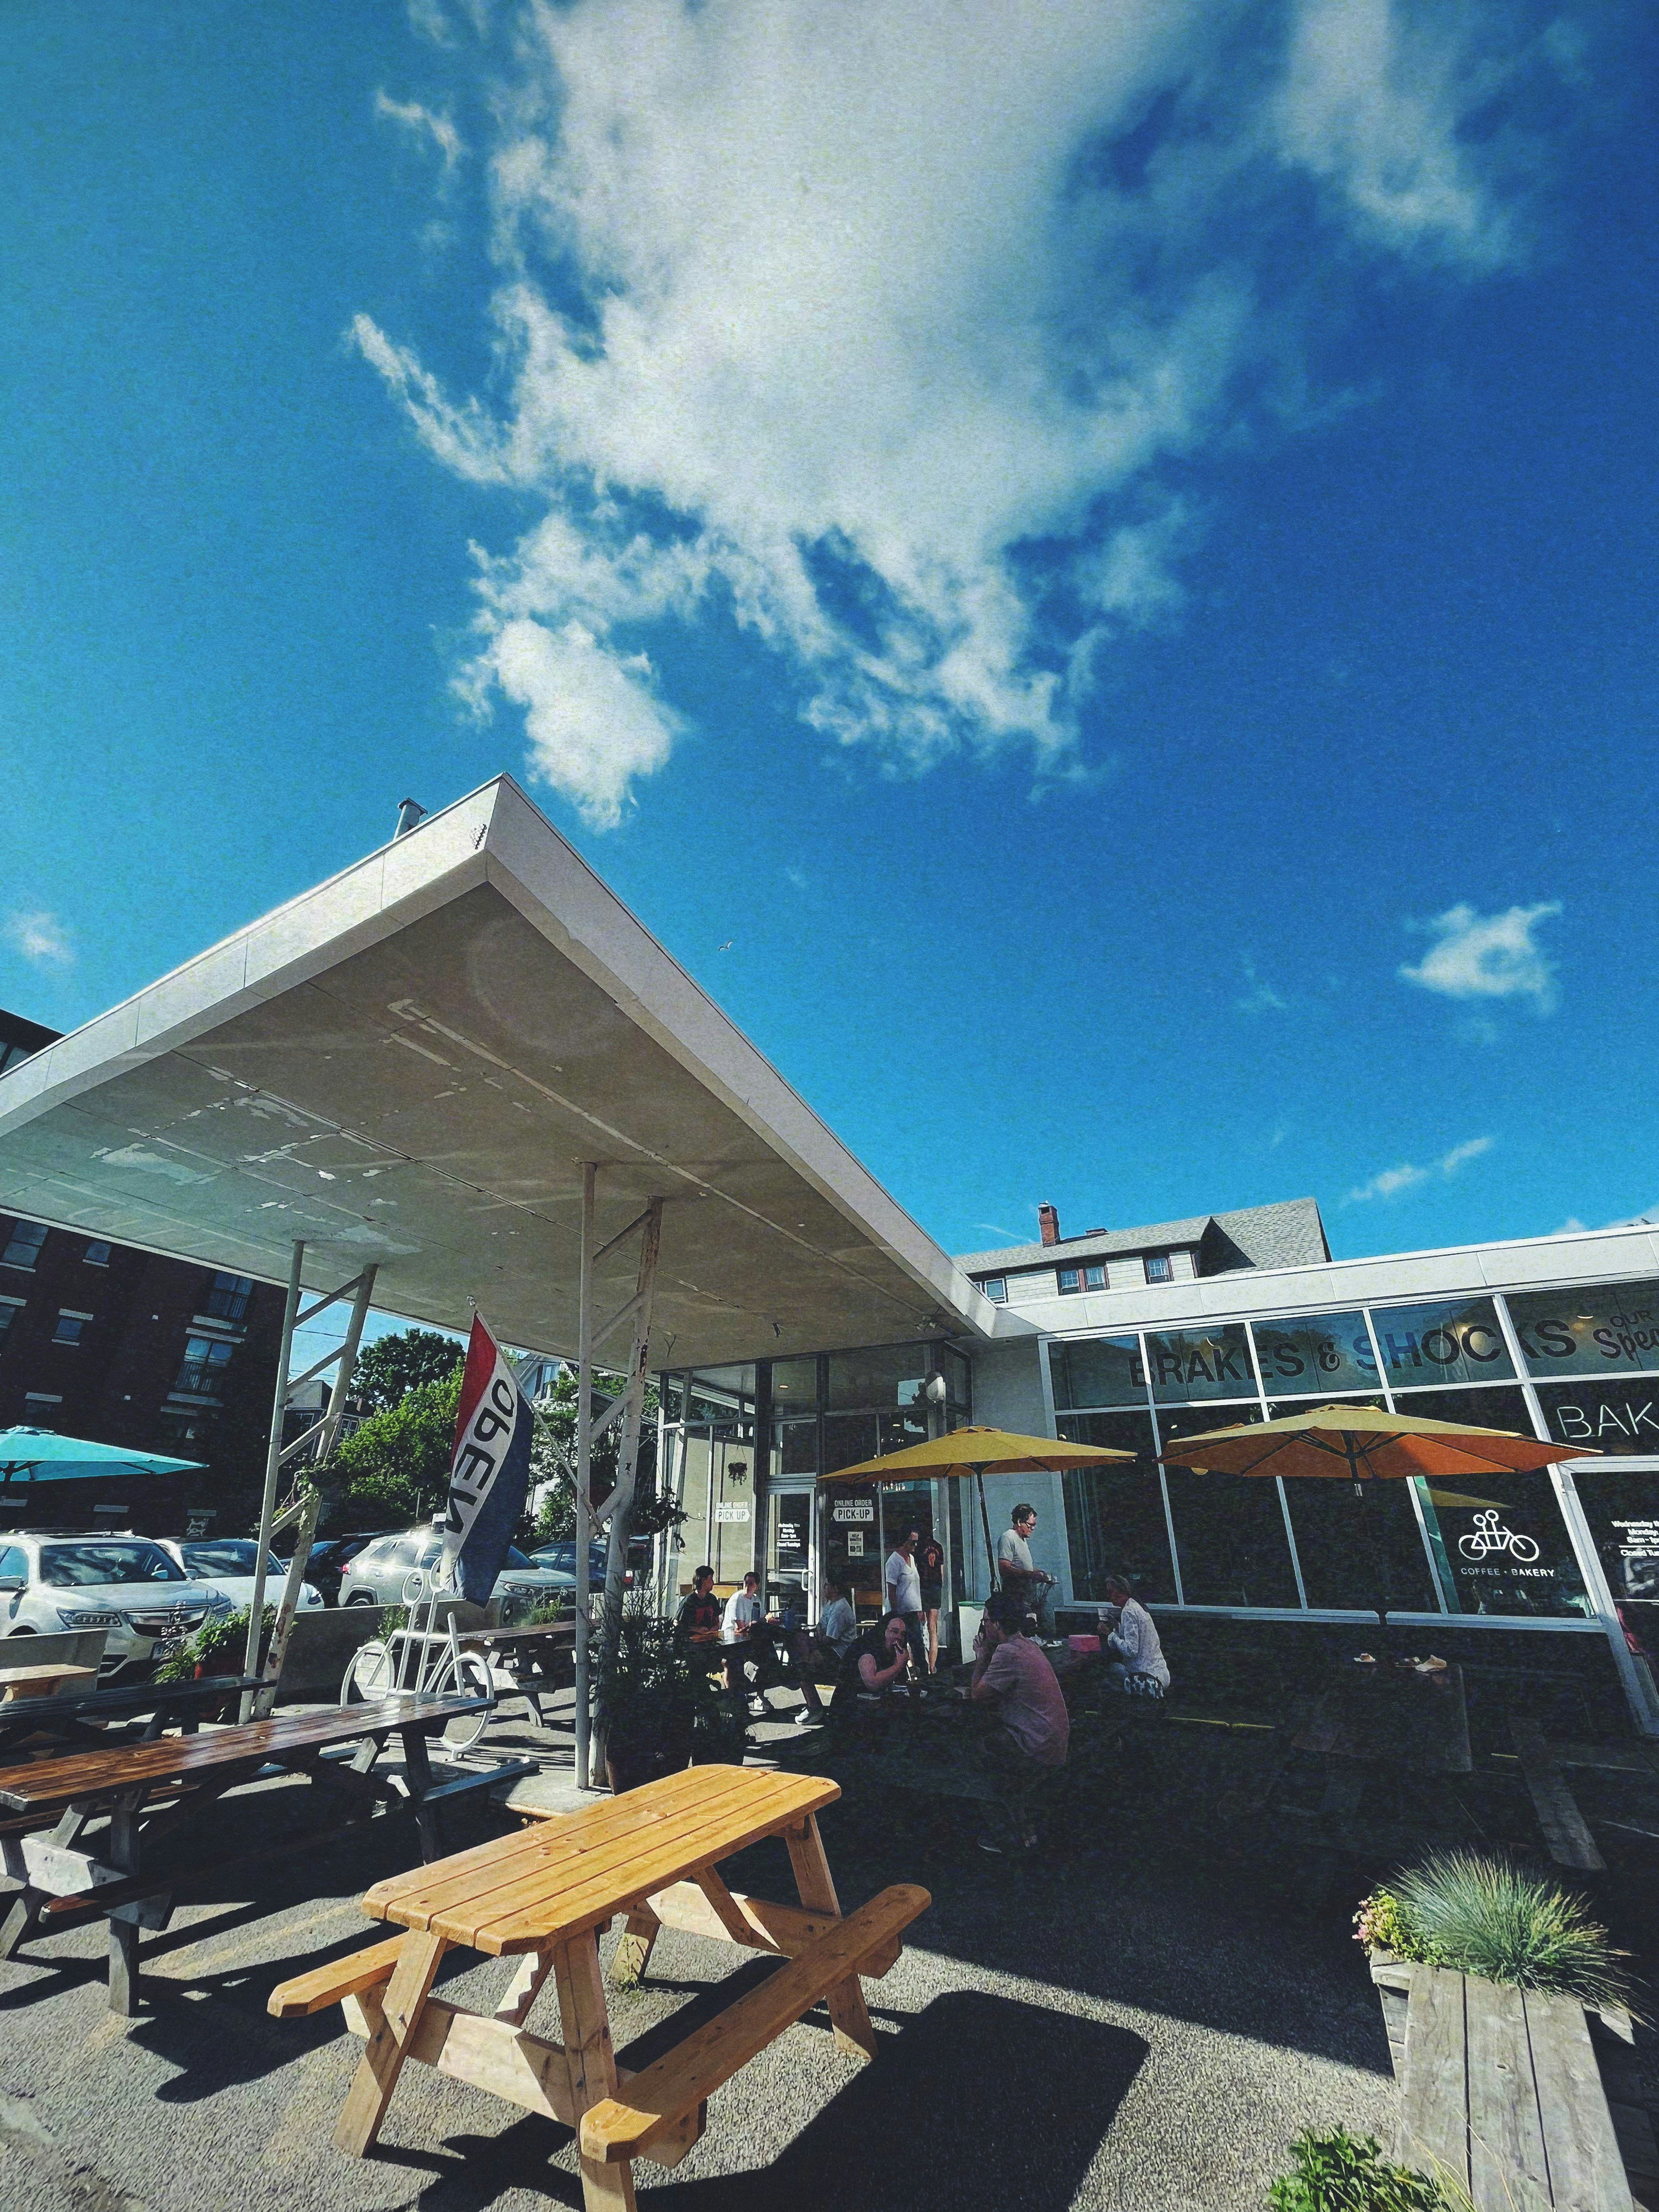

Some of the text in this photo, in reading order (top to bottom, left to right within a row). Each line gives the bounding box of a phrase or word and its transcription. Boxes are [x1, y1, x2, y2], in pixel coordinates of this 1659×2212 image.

[1609, 1309, 1655, 1328] OUR
[1128, 1318, 1577, 1388] BRAKES & SHOCKS
[1557, 1402, 1659, 1438] BAK
[718, 1511, 746, 1520] PICK UP
[838, 1509, 870, 1519] PICK-UP
[1460, 1567, 1555, 1577] COFFEE BAKERY
